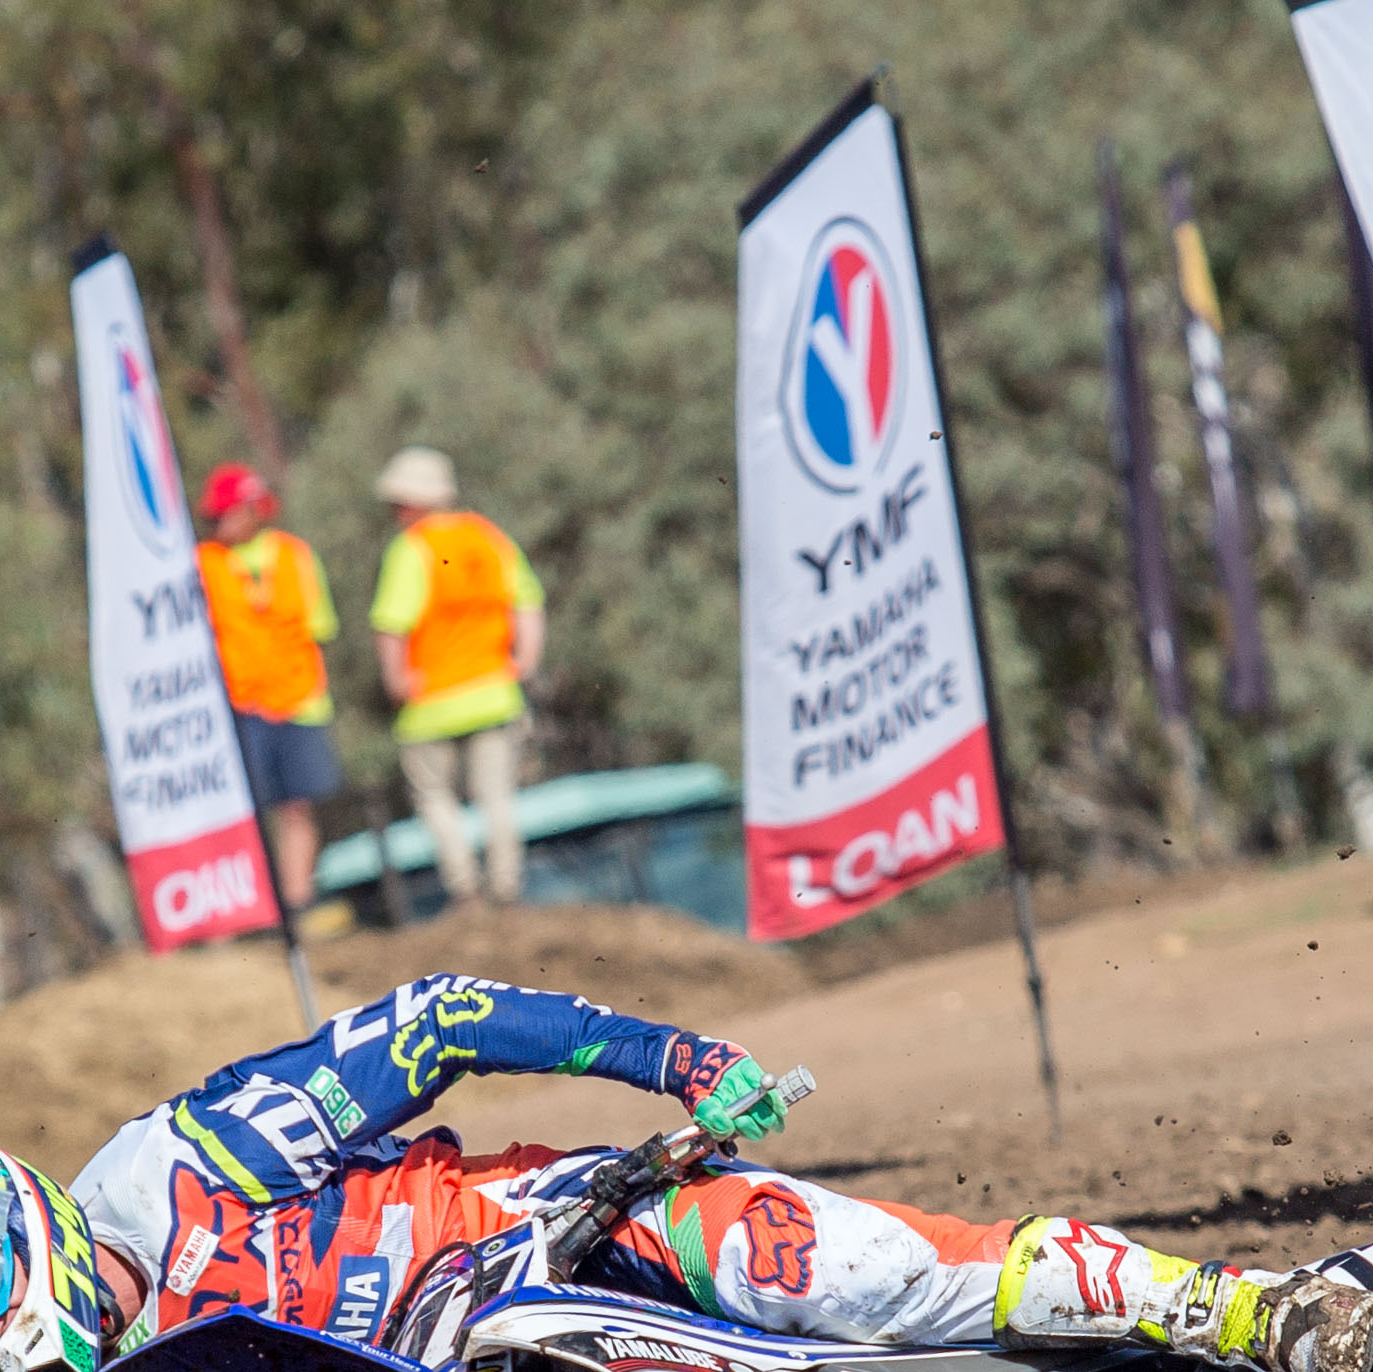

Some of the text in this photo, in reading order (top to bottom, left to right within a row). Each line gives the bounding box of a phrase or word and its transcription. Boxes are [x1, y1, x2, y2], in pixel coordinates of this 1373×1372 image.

[798, 462, 926, 595] YMF
[789, 556, 941, 674] YAMAHA
[791, 622, 927, 732] MOTOR
[795, 661, 961, 789] FINANCE
[153, 850, 260, 932] OAN
[789, 774, 980, 906] LOAN
[306, 1066, 366, 1139] 360
[177, 1228, 209, 1276] YAMAHA
[594, 1336, 724, 1372] YAMALUBE
